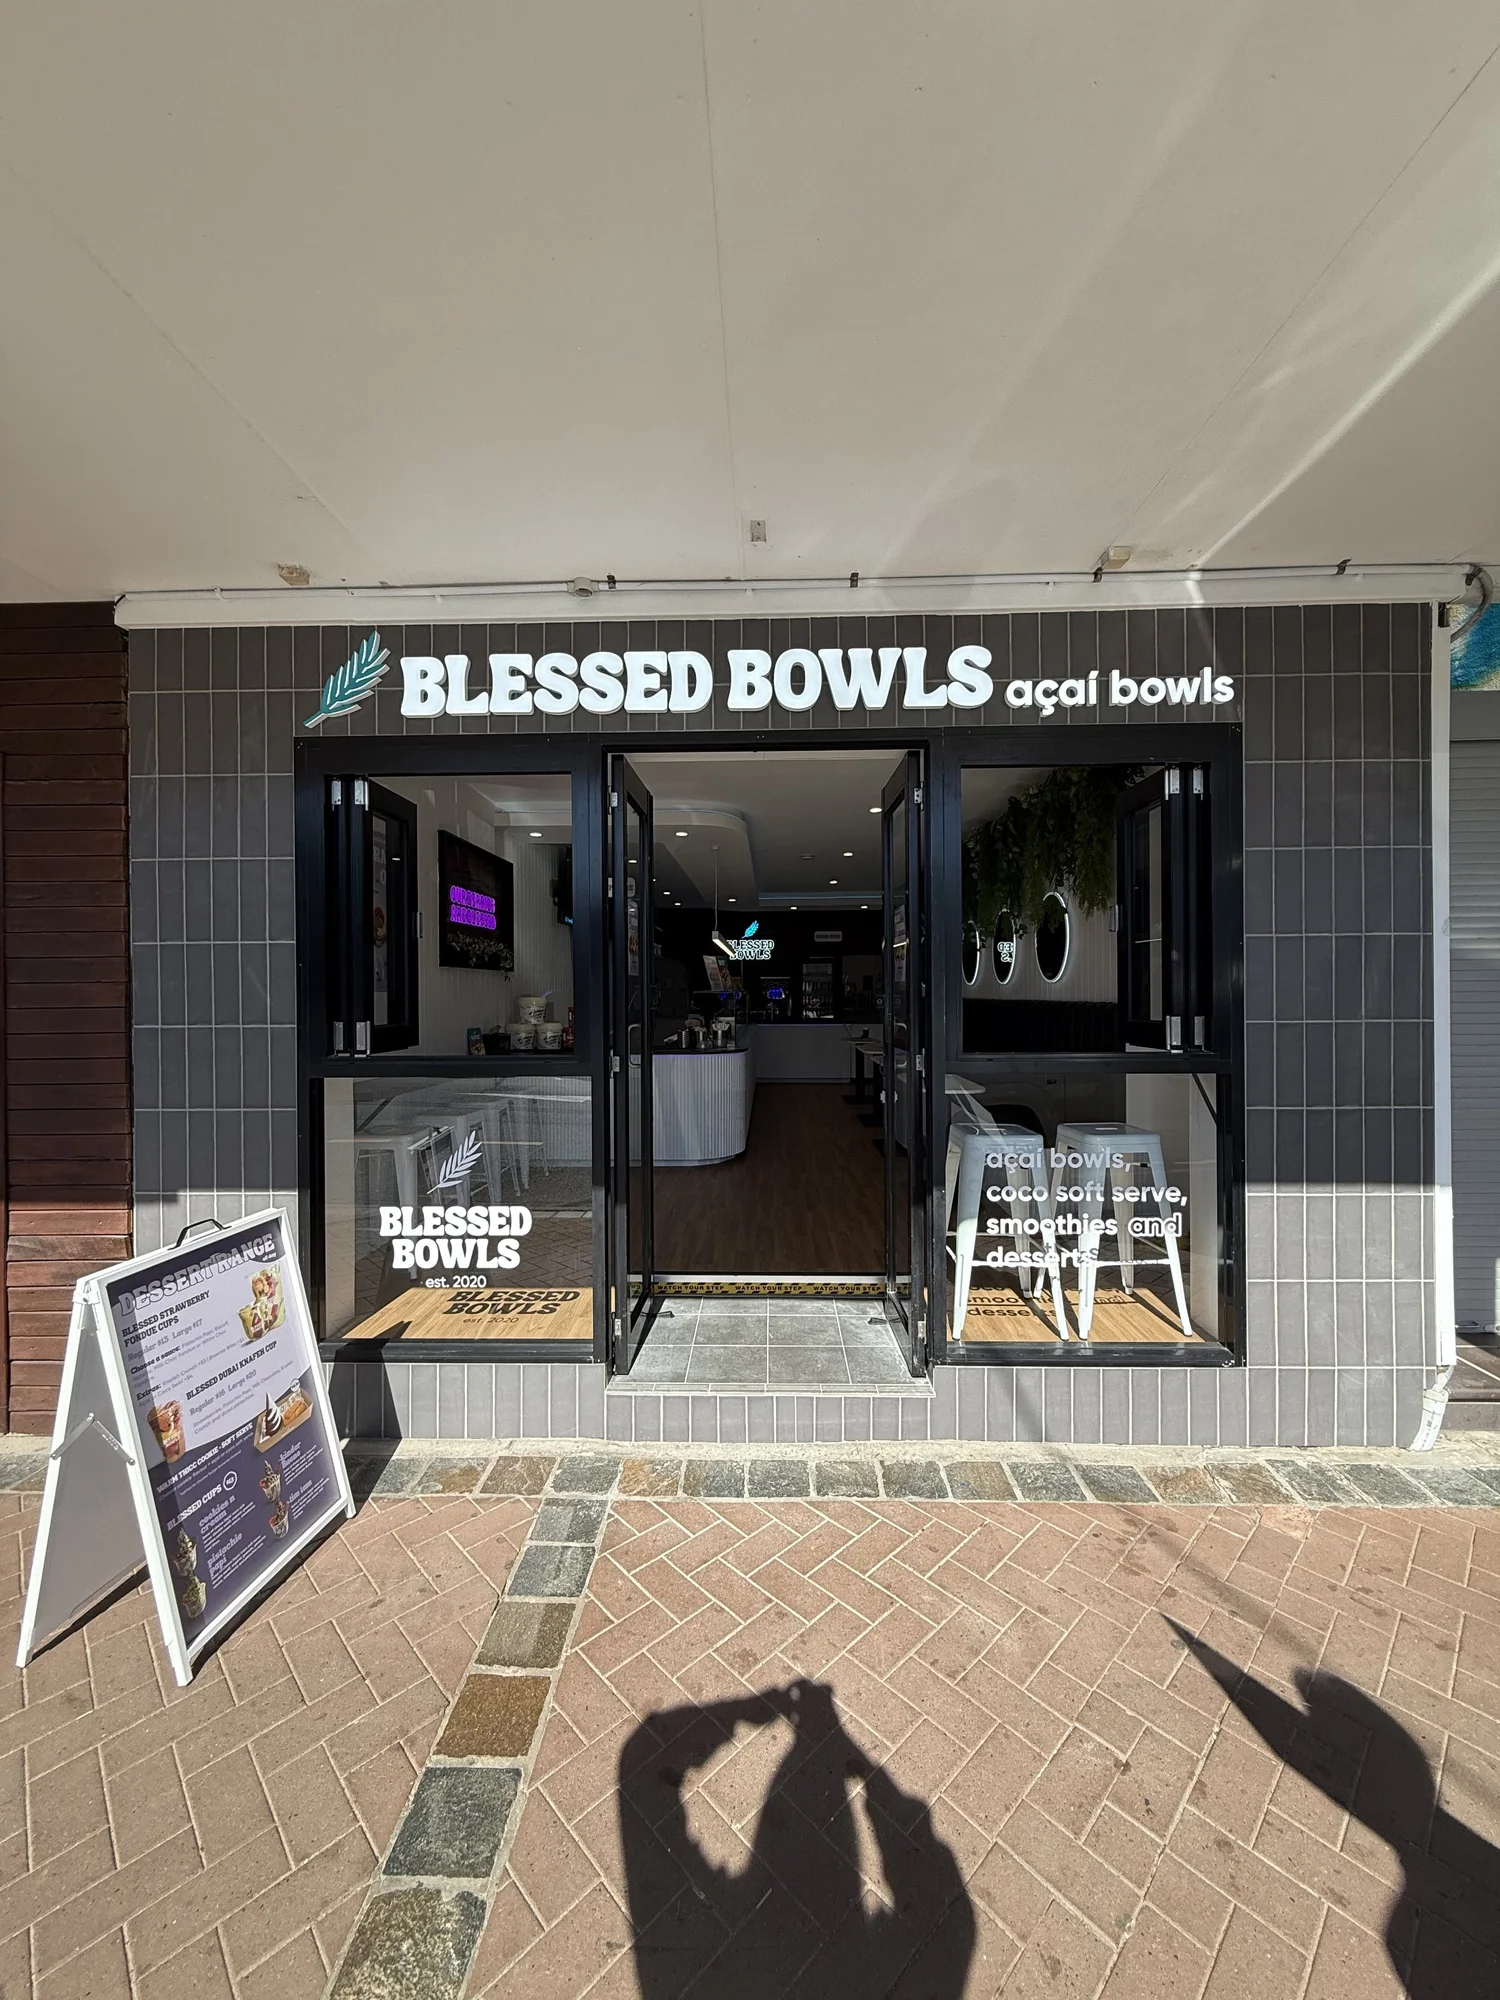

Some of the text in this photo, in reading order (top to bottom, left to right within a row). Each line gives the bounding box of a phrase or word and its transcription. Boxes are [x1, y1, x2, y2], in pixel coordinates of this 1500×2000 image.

[400, 645, 994, 717] BLESSED BOWLS
[1004, 667, 1235, 717] açaí bowls
[726, 939, 775, 950] LESSED
[986, 1148, 1131, 1174] açaí bowls,
[986, 1180, 1188, 1206] coco soft serve,
[379, 1205, 532, 1237] BLESSED
[986, 1212, 1182, 1237] smoothies and
[392, 1238, 521, 1269] BOWLS
[118, 1232, 276, 1316] DESSERT RANGE
[425, 1275, 487, 1288] est. 2020
[442, 1302, 561, 1315] BOWLS
[447, 1291, 581, 1302] BLESSED
[121, 1290, 210, 1337] BLESSED STRAWBERRY
[123, 1315, 179, 1348] FONDUE CUPS
[127, 1318, 203, 1363] Regular $13 Large $17
[130, 1357, 155, 1375] Choose
[185, 1340, 277, 1400] BLESSED DUBAI KNAFEH CUP
[136, 1381, 161, 1401] Extras:
[189, 1394, 215, 1417] Regular
[227, 1376, 245, 1393] Large
[245, 1368, 257, 1381] $20
[156, 1421, 253, 1494] WARM THICC COOKIE SOFT SERVE
[279, 1439, 301, 1462] kinder
[166, 1498, 202, 1531] BLESSED
[201, 1483, 222, 1504] CUPS
[197, 1494, 235, 1528] cookies n
[200, 1508, 227, 1535] cream
[206, 1529, 243, 1569] pistachio
[208, 1553, 227, 1578] papi
